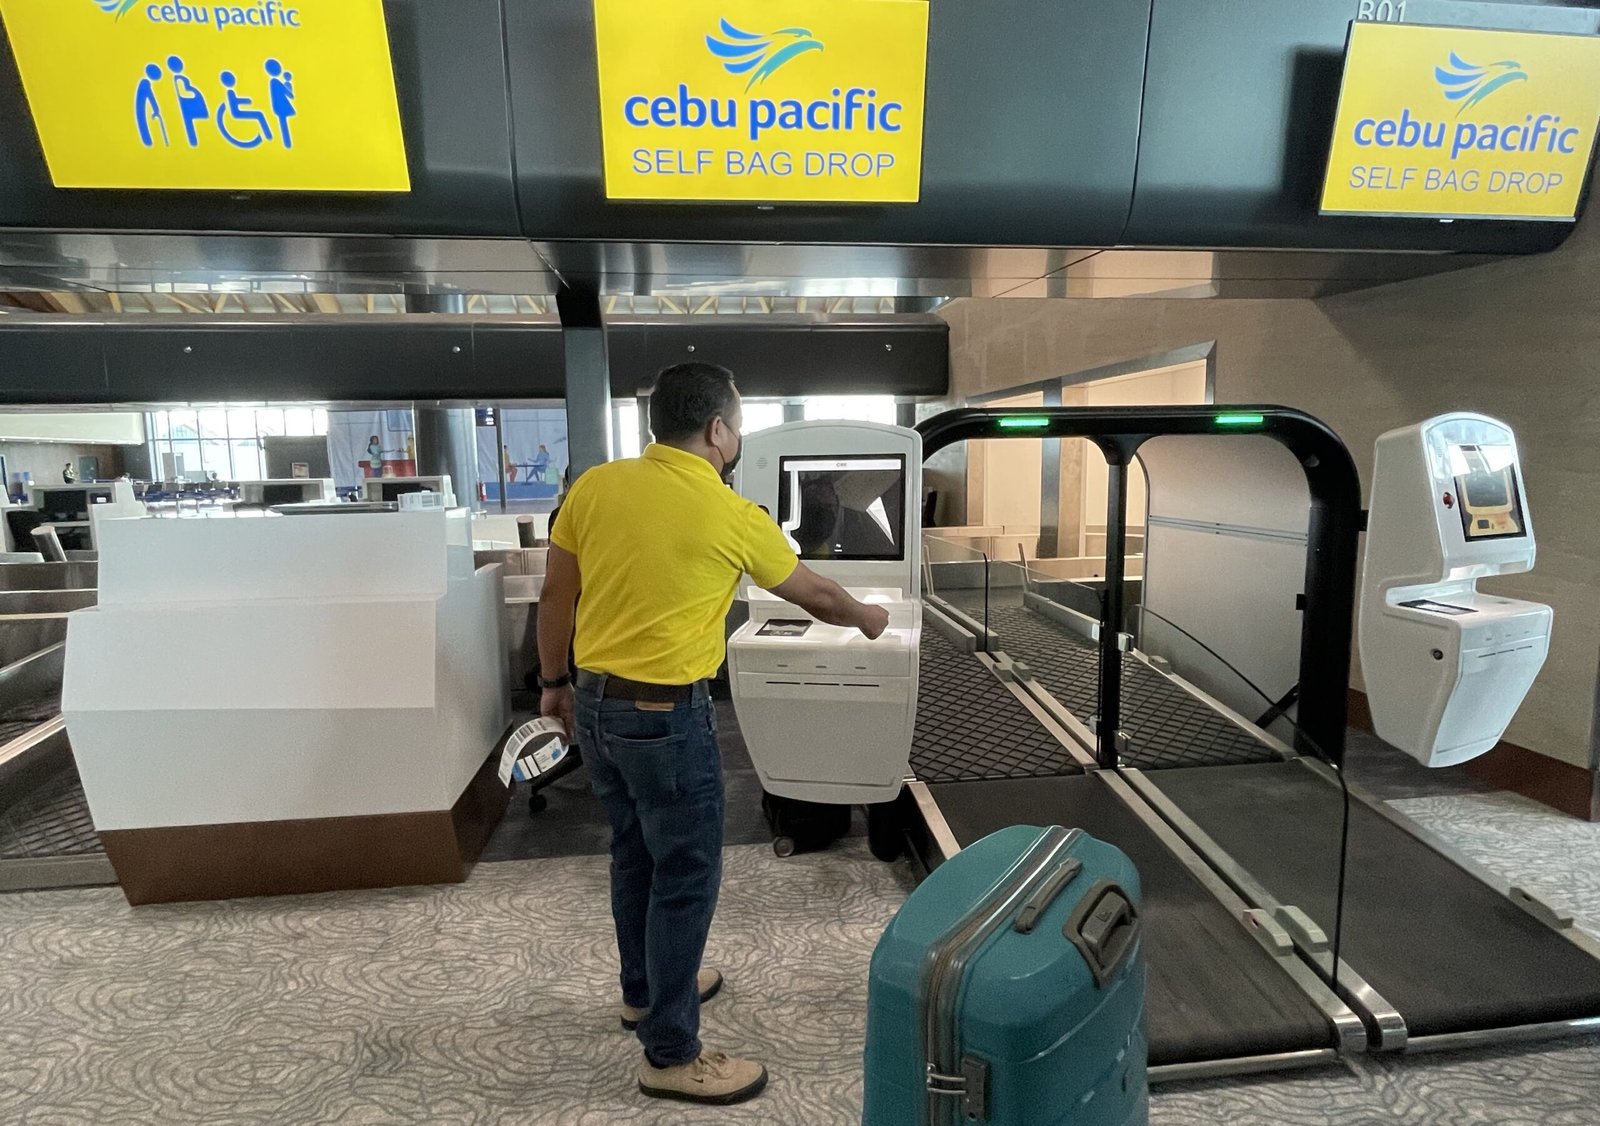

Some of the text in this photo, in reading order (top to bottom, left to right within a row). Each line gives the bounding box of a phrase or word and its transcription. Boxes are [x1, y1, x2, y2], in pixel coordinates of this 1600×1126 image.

[146, 0, 301, 31] cebu pacific
[623, 83, 903, 141] cebu pacific
[1353, 107, 1580, 160] cebu pacific
[631, 147, 896, 178] SELF BAG DROP
[1348, 165, 1564, 195] SELF BAG DROP
